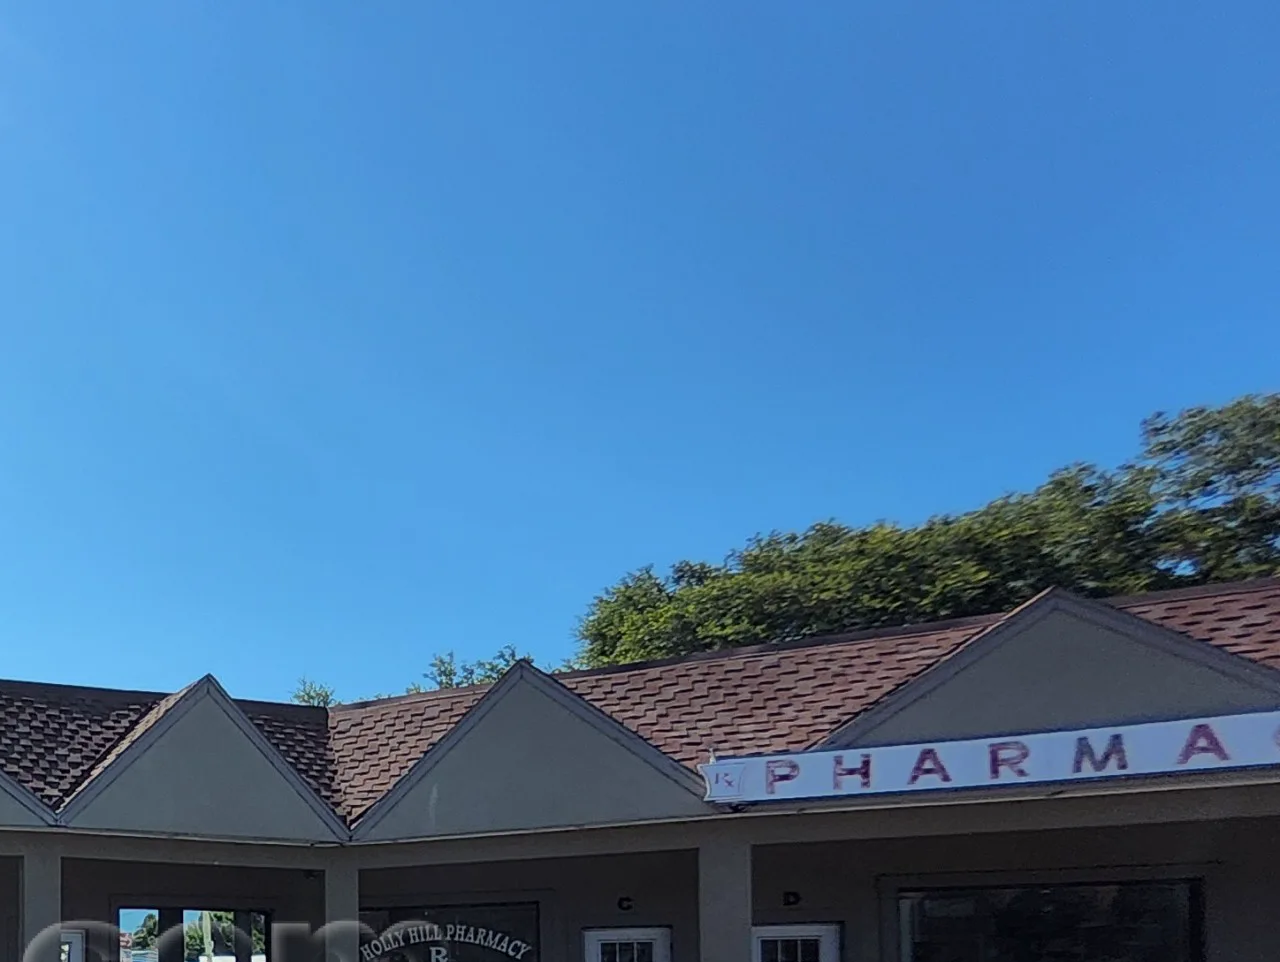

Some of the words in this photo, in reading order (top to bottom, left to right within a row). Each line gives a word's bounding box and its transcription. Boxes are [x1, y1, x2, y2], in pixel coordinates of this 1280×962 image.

[765, 723, 1280, 795] PHARMA
[617, 896, 633, 911] C
[783, 891, 801, 906] D
[360, 930, 406, 961] HOLLY
[408, 924, 442, 944] HILL
[445, 923, 532, 961] PHARMACY
